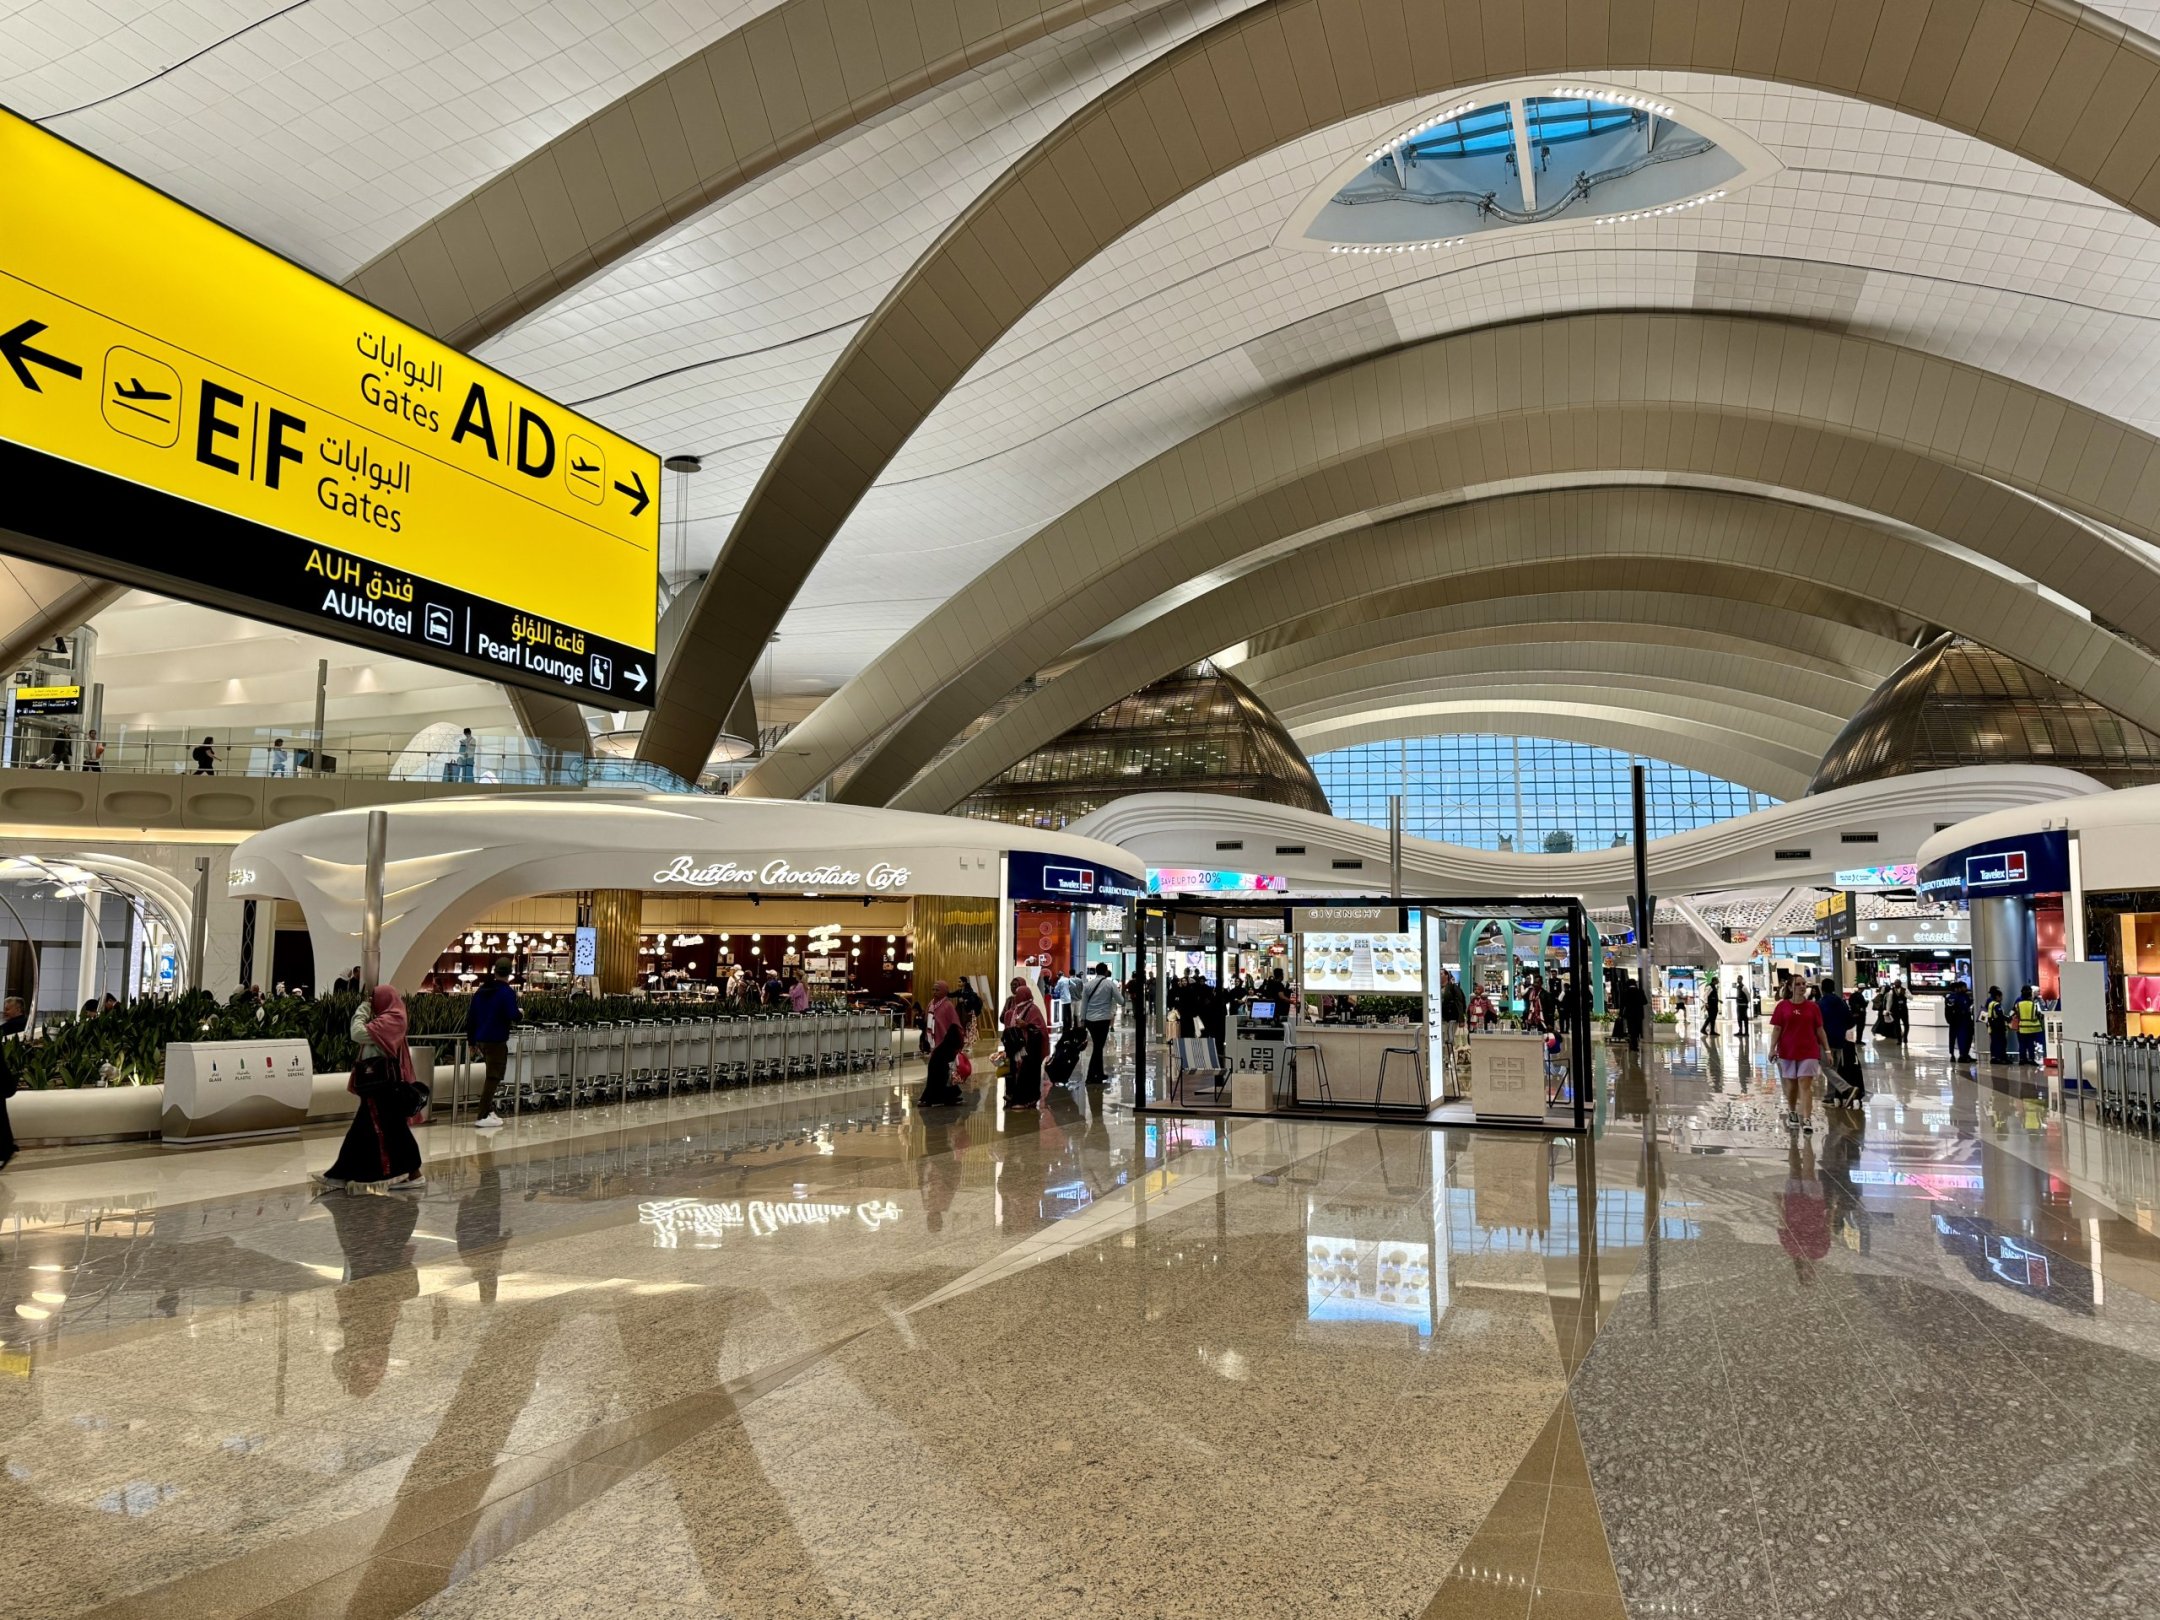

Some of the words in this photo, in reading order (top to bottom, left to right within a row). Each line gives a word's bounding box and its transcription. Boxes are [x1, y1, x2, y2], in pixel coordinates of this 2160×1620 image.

[356, 331, 442, 393] البوابات
[361, 373, 440, 433] Gates
[319, 437, 411, 494] البوابات
[317, 476, 402, 533] Gates
[304, 548, 361, 587] AUH
[366, 570, 414, 602] فندق
[321, 588, 413, 635] AUHotel
[511, 614, 552, 646] اللؤلؤ
[554, 629, 585, 655] قاعة
[478, 633, 521, 665] Pearl
[525, 647, 584, 685] Lounge
[653, 855, 757, 887] Butlers
[760, 859, 861, 885] Chocolate
[866, 862, 912, 891] Café
[1058, 878, 1080, 889] Travelex
[1161, 877, 1175, 885] SAVE
[1176, 876, 1185, 884] UP
[1186, 875, 1197, 884] TO
[1198, 872, 1221, 884] 20%
[1980, 868, 2006, 880] Travelex
[1308, 908, 1381, 919] GIVENCHY
[1913, 932, 1958, 943] CHANEL
